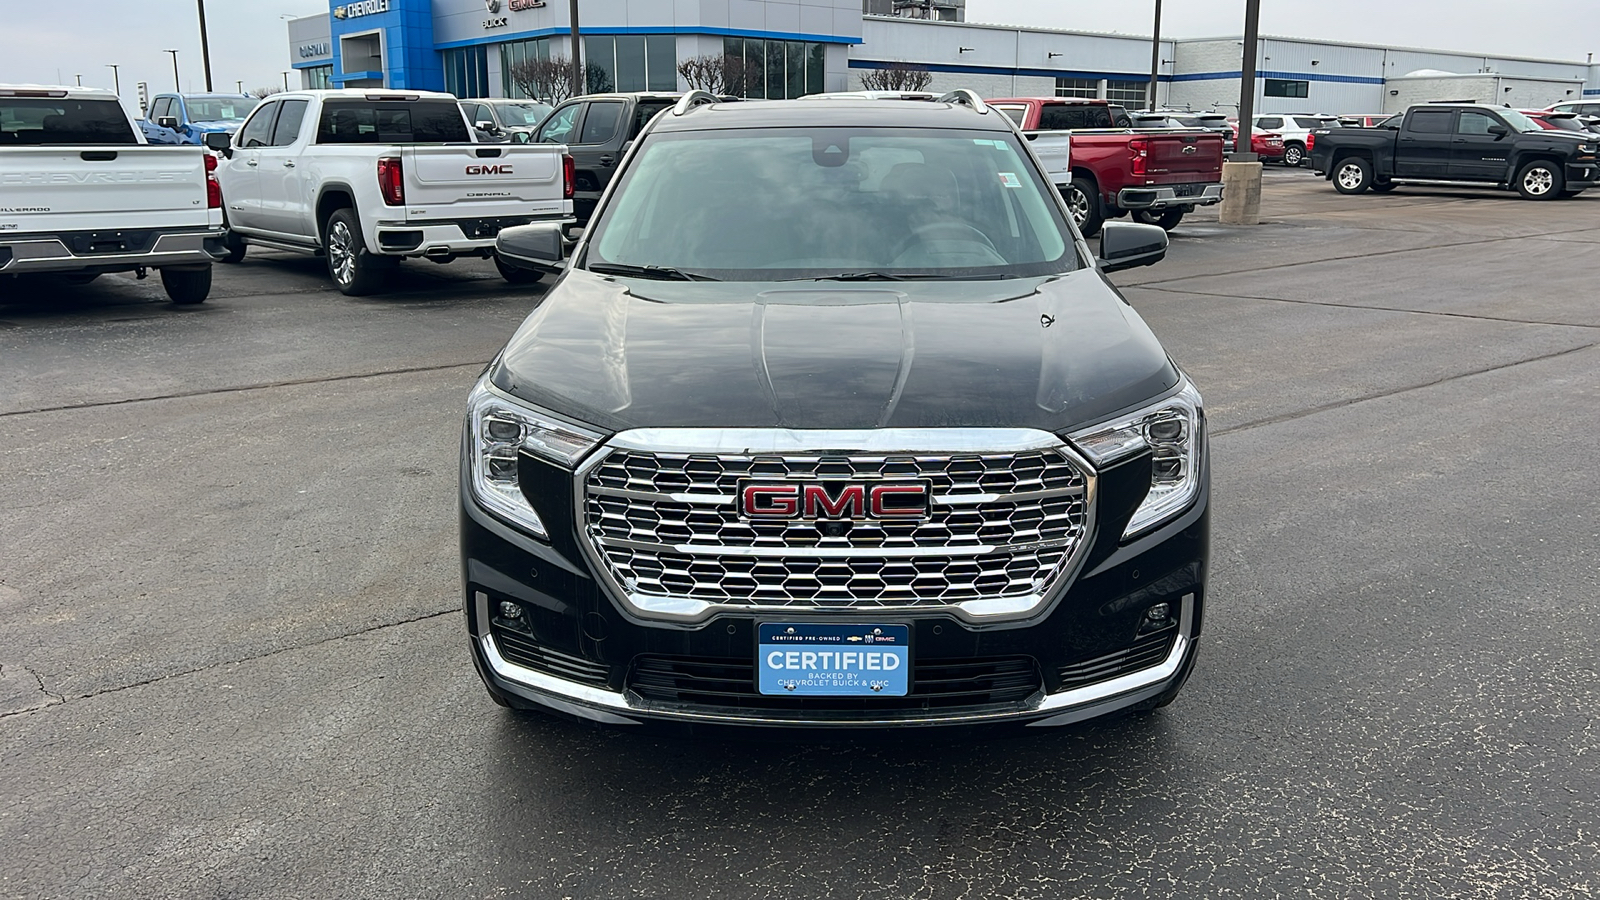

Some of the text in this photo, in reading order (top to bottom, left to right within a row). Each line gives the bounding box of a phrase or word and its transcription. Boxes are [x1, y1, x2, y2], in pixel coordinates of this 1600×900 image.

[347, 0, 389, 18] CHEVROLET
[483, 17, 507, 29] BUICK
[2, 170, 193, 184] CHEVROLET
[465, 164, 514, 175] GMC
[743, 485, 927, 518] GMC
[767, 651, 900, 671] CERTIFIED
